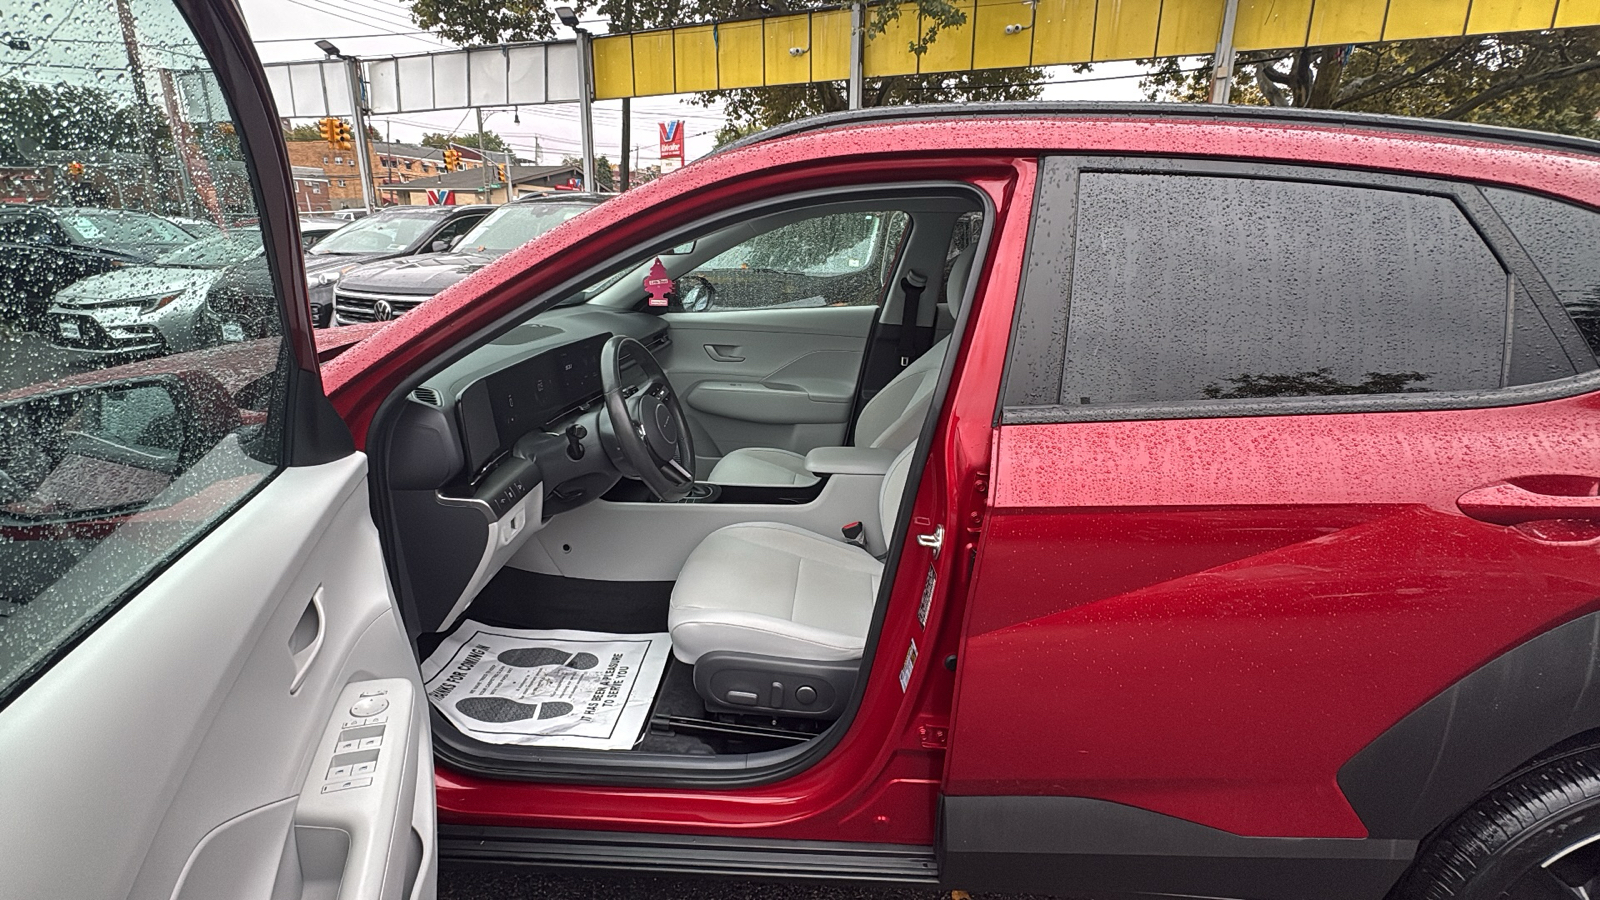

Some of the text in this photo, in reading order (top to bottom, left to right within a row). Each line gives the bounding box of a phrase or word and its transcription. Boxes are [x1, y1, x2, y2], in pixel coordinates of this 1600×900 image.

[446, 671, 468, 684] FOR
[457, 648, 485, 671] COMING
[475, 643, 491, 652] IN
[602, 653, 623, 680] PLEASURE
[591, 687, 607, 701] BEEN
[602, 666, 629, 707] TO SERVE YOU
[584, 703, 599, 715] HAS
